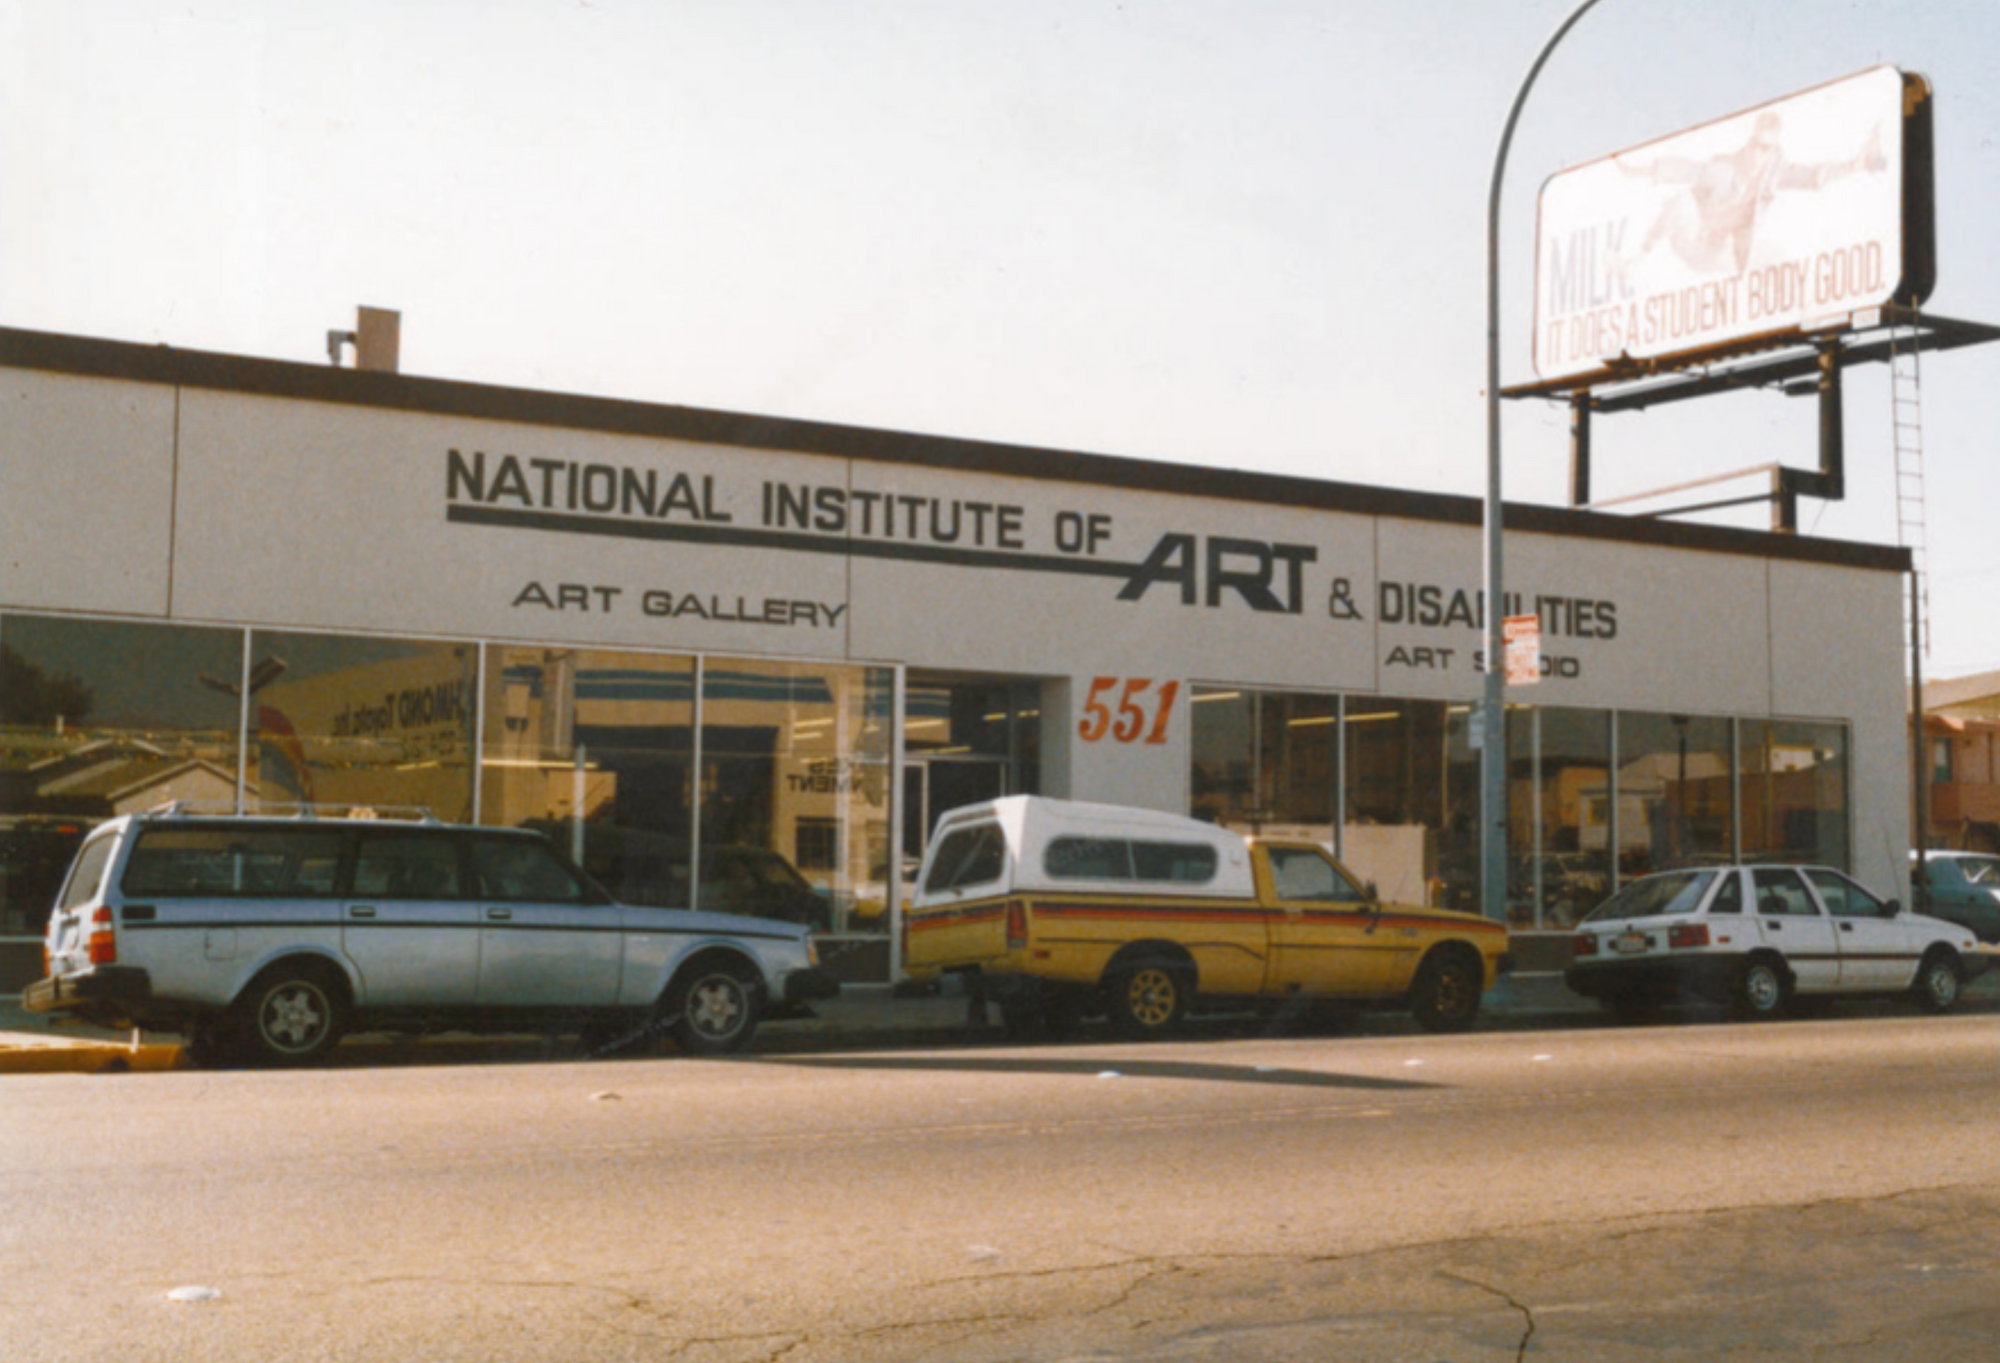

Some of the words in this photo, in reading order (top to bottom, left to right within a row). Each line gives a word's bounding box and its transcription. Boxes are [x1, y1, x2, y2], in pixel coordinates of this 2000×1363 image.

[1546, 318, 1566, 368] IT
[1569, 304, 1622, 362] DOES
[1625, 300, 1641, 349] A
[1643, 275, 1743, 345] STUDENT
[1747, 256, 1810, 322] BODY
[1813, 238, 1886, 307] GOOD.
[446, 449, 732, 522] NATIONAL
[762, 481, 1024, 549] INSTITUTE
[1054, 510, 1112, 555] OF
[1116, 532, 1318, 614] ART
[1329, 578, 1363, 620] &
[1379, 581, 1617, 639] DISAIITIES
[511, 582, 622, 612] ART
[642, 590, 847, 628] GALLERY
[1385, 646, 1455, 669] ART
[1473, 651, 1580, 678] SDIO
[1078, 676, 1180, 744] 551
